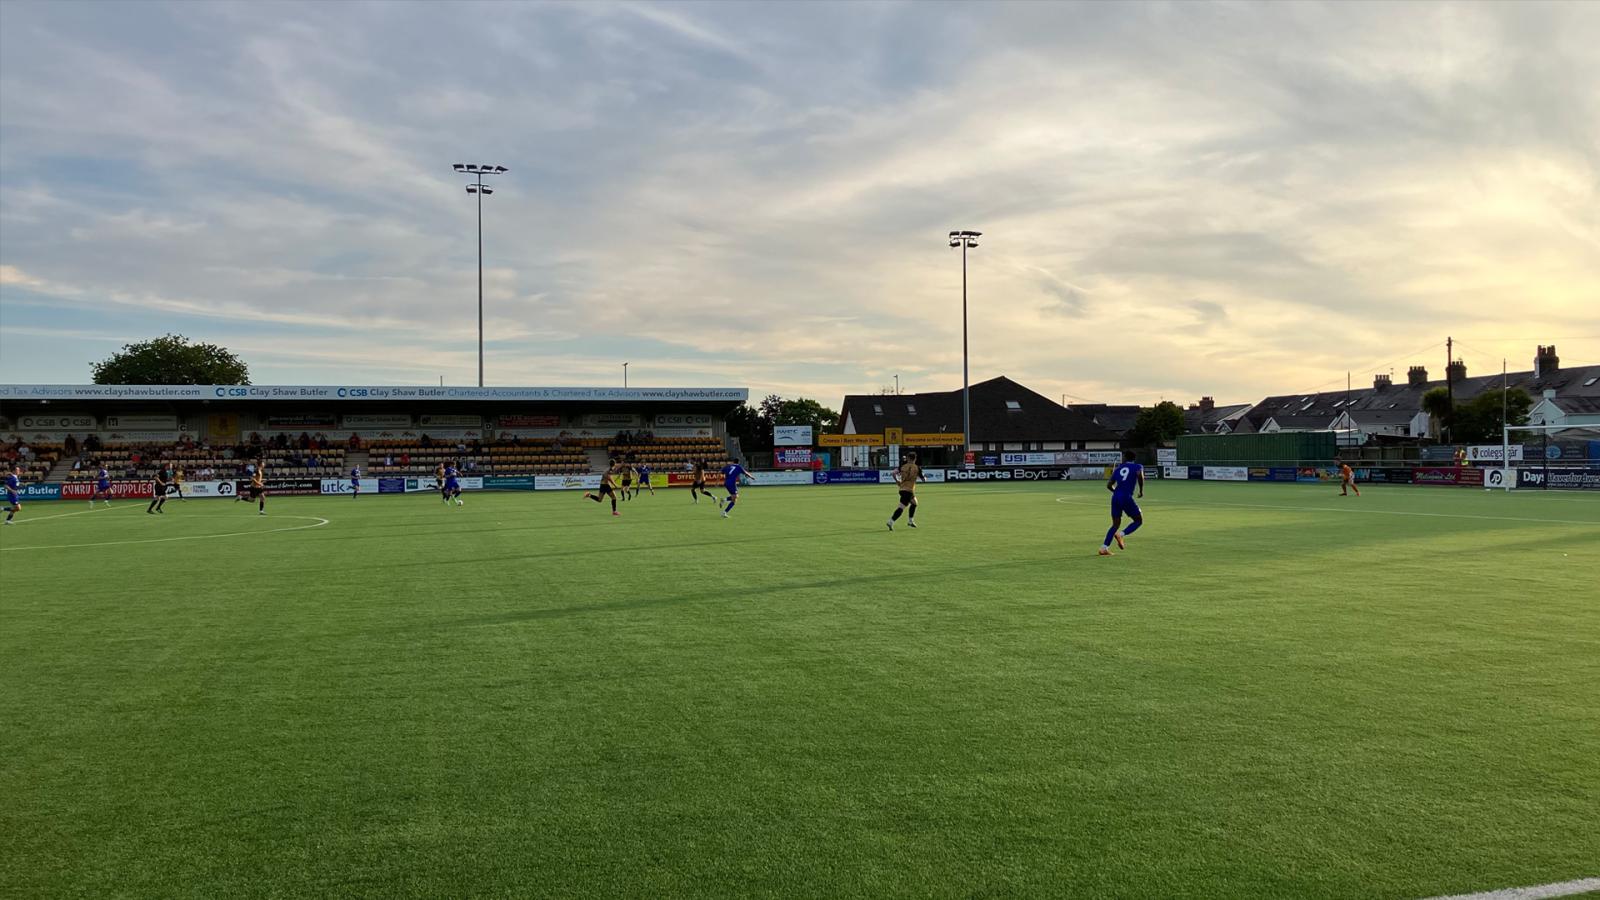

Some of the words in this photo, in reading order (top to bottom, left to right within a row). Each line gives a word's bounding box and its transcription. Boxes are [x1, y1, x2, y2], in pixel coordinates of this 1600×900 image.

[32, 387, 73, 396] Advisors
[75, 388, 200, 397] www.clayshawbutler.com
[229, 388, 248, 397] CSB
[250, 388, 268, 398] Clay
[273, 388, 298, 396] Shaw
[301, 388, 328, 396] Butler
[350, 389, 368, 397] CSB
[370, 389, 388, 398] Clay
[448, 389, 489, 397] Chartered
[492, 389, 540, 397] Accountants
[552, 390, 591, 398] Chartered
[608, 390, 640, 398] Advisors
[641, 390, 741, 399] www.clayshawbutler.com
[946, 469, 1011, 480] Roberts
[1014, 468, 1049, 480] Boyt
[1119, 467, 1130, 481] 9
[28, 486, 59, 495] Butler
[62, 483, 91, 495] CYMRU
[112, 482, 152, 495] SUPPLIES
[322, 480, 345, 492] utk
